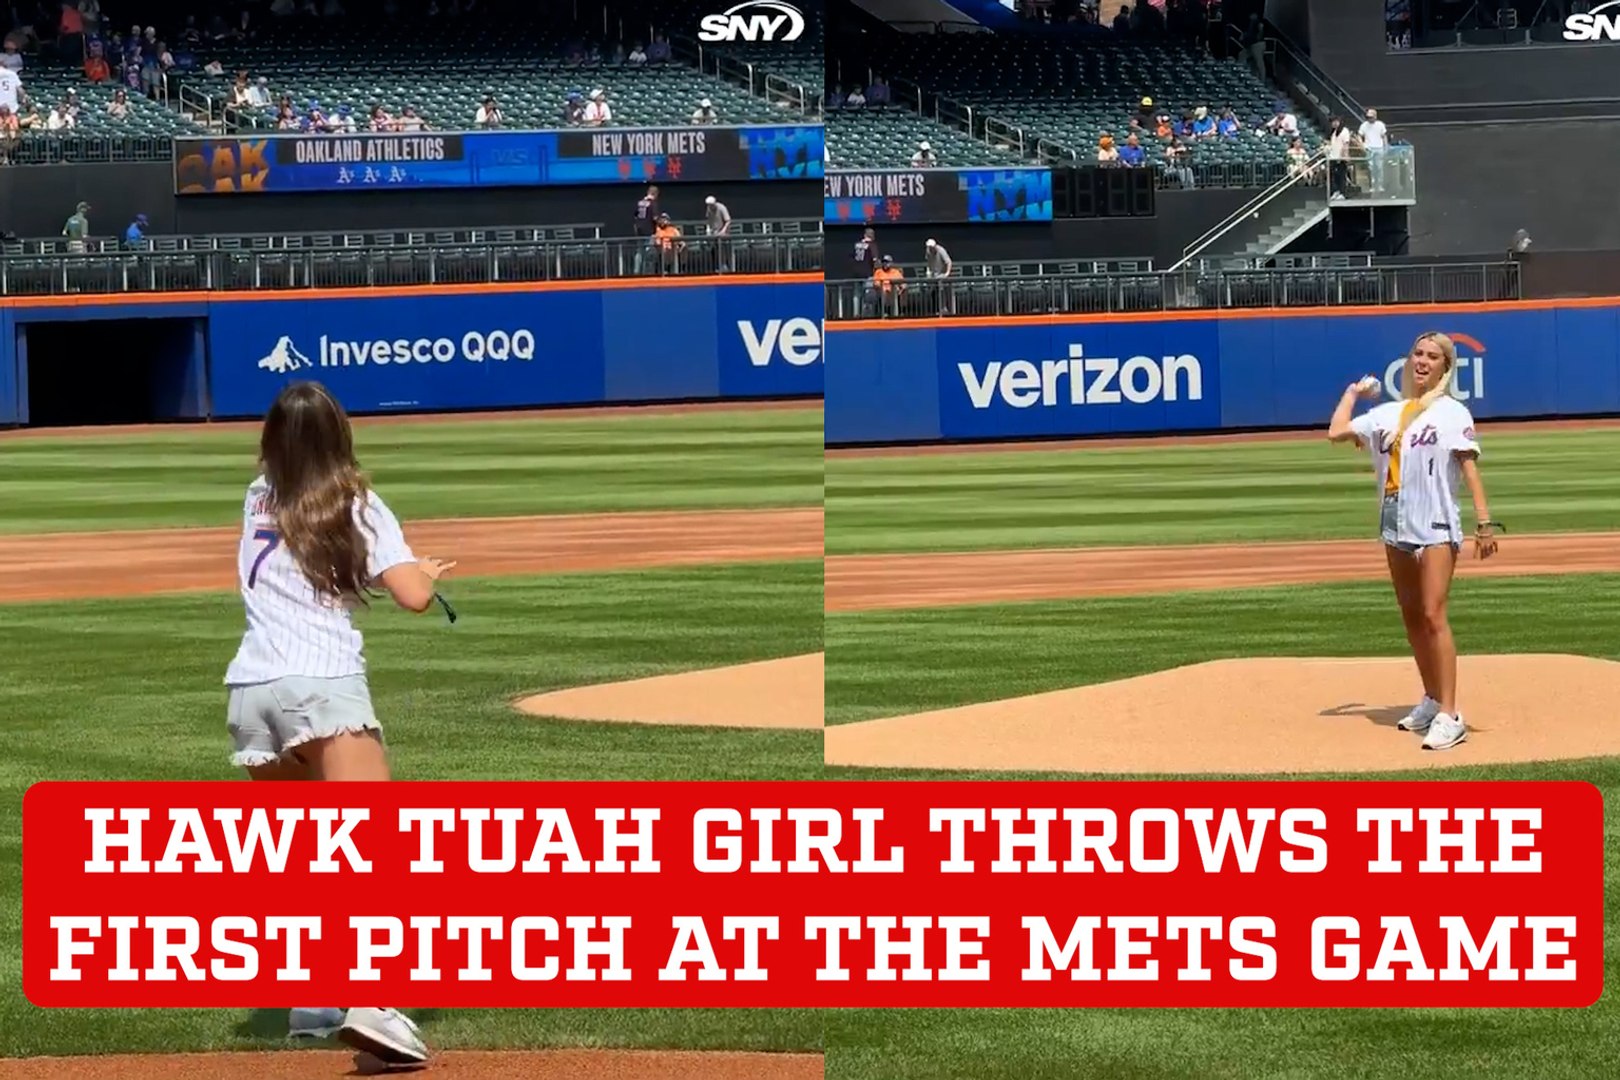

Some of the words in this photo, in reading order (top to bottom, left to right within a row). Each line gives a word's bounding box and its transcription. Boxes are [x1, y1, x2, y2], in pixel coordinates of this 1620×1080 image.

[296, 140, 362, 163] OAKLAND
[366, 137, 445, 161] ATHLETICS
[592, 134, 623, 156] NEW
[626, 132, 664, 155] YORK
[667, 131, 706, 154] METS
[845, 175, 883, 197] YORK
[886, 174, 926, 196] METS
[320, 334, 455, 367] Invesco
[462, 329, 536, 362] QQQ
[737, 317, 824, 366] ve
[958, 343, 1203, 409] verizon
[1384, 355, 1484, 400] cti
